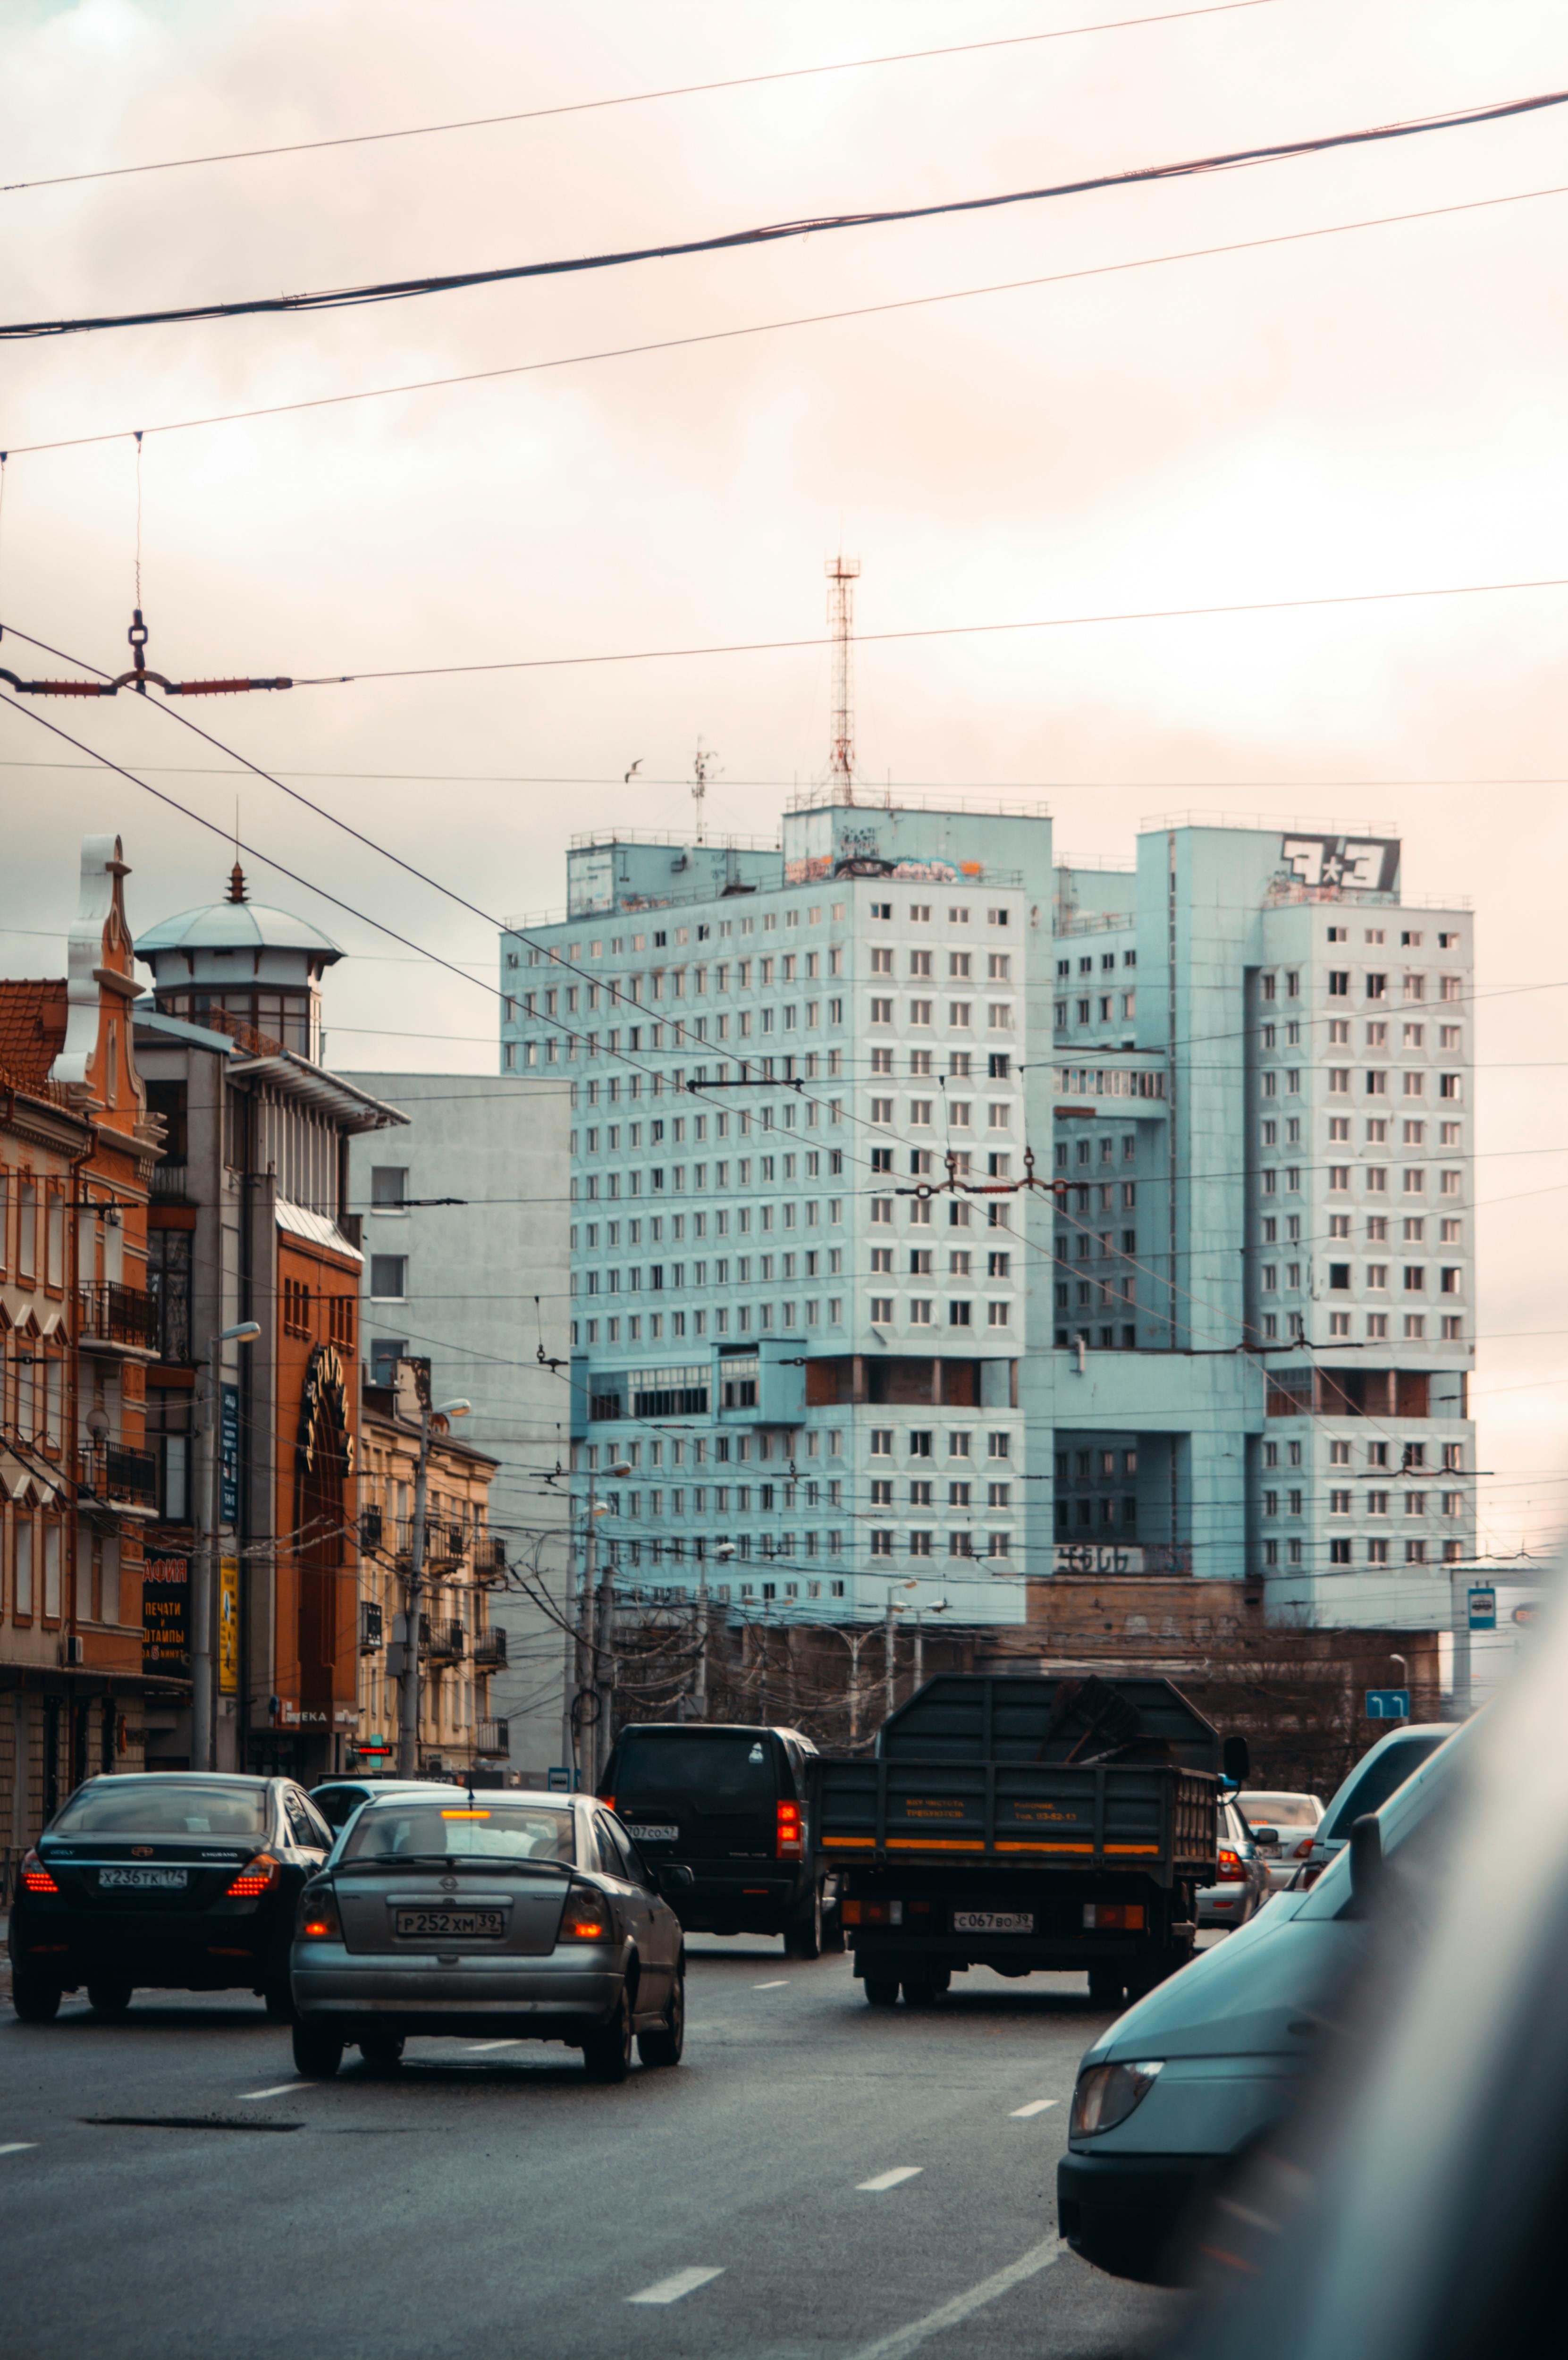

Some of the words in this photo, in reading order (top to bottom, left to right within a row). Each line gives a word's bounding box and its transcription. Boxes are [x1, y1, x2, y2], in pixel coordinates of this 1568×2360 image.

[145, 1602, 181, 1616] ПЕЧАТИ
[142, 1630, 185, 1643] ШТАМПЫ
[151, 1645, 159, 1660] 5
